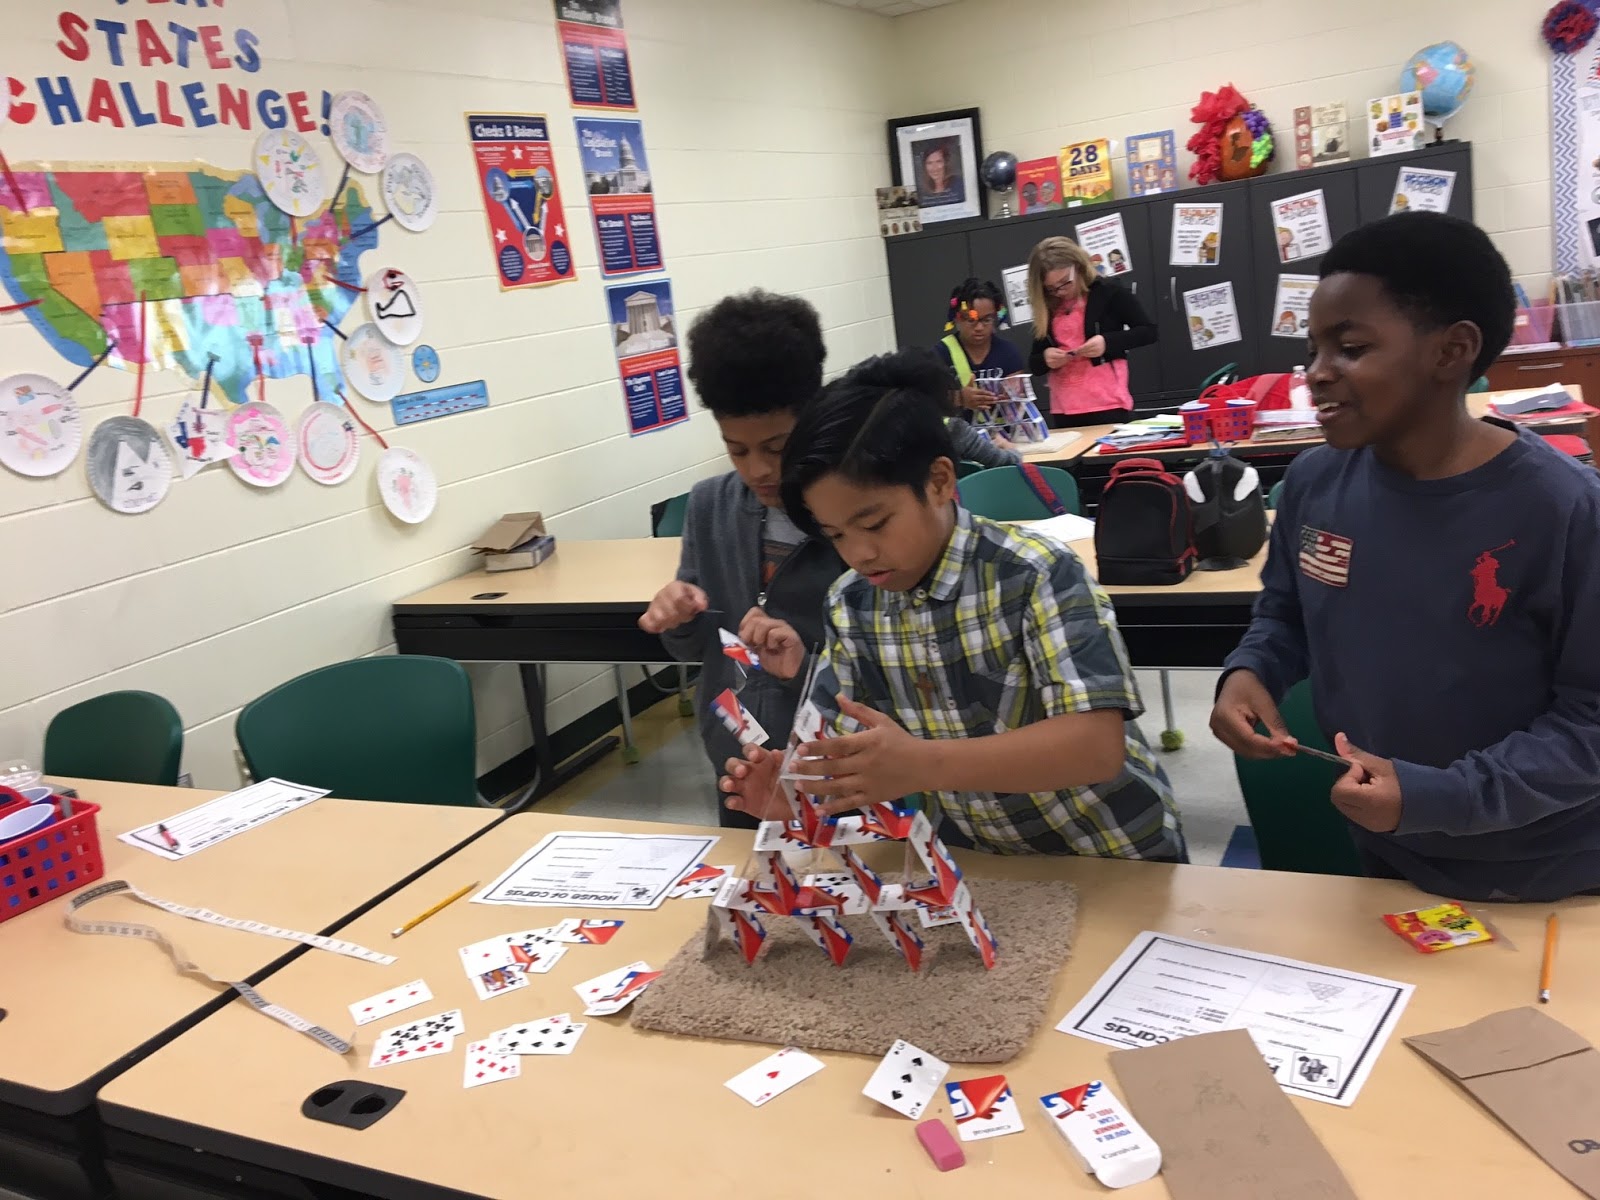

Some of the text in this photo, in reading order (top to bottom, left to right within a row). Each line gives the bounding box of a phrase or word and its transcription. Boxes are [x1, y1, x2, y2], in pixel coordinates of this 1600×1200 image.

[56, 11, 261, 73] STATES
[1069, 144, 1098, 166] 28
[1069, 163, 1101, 177] DAYS
